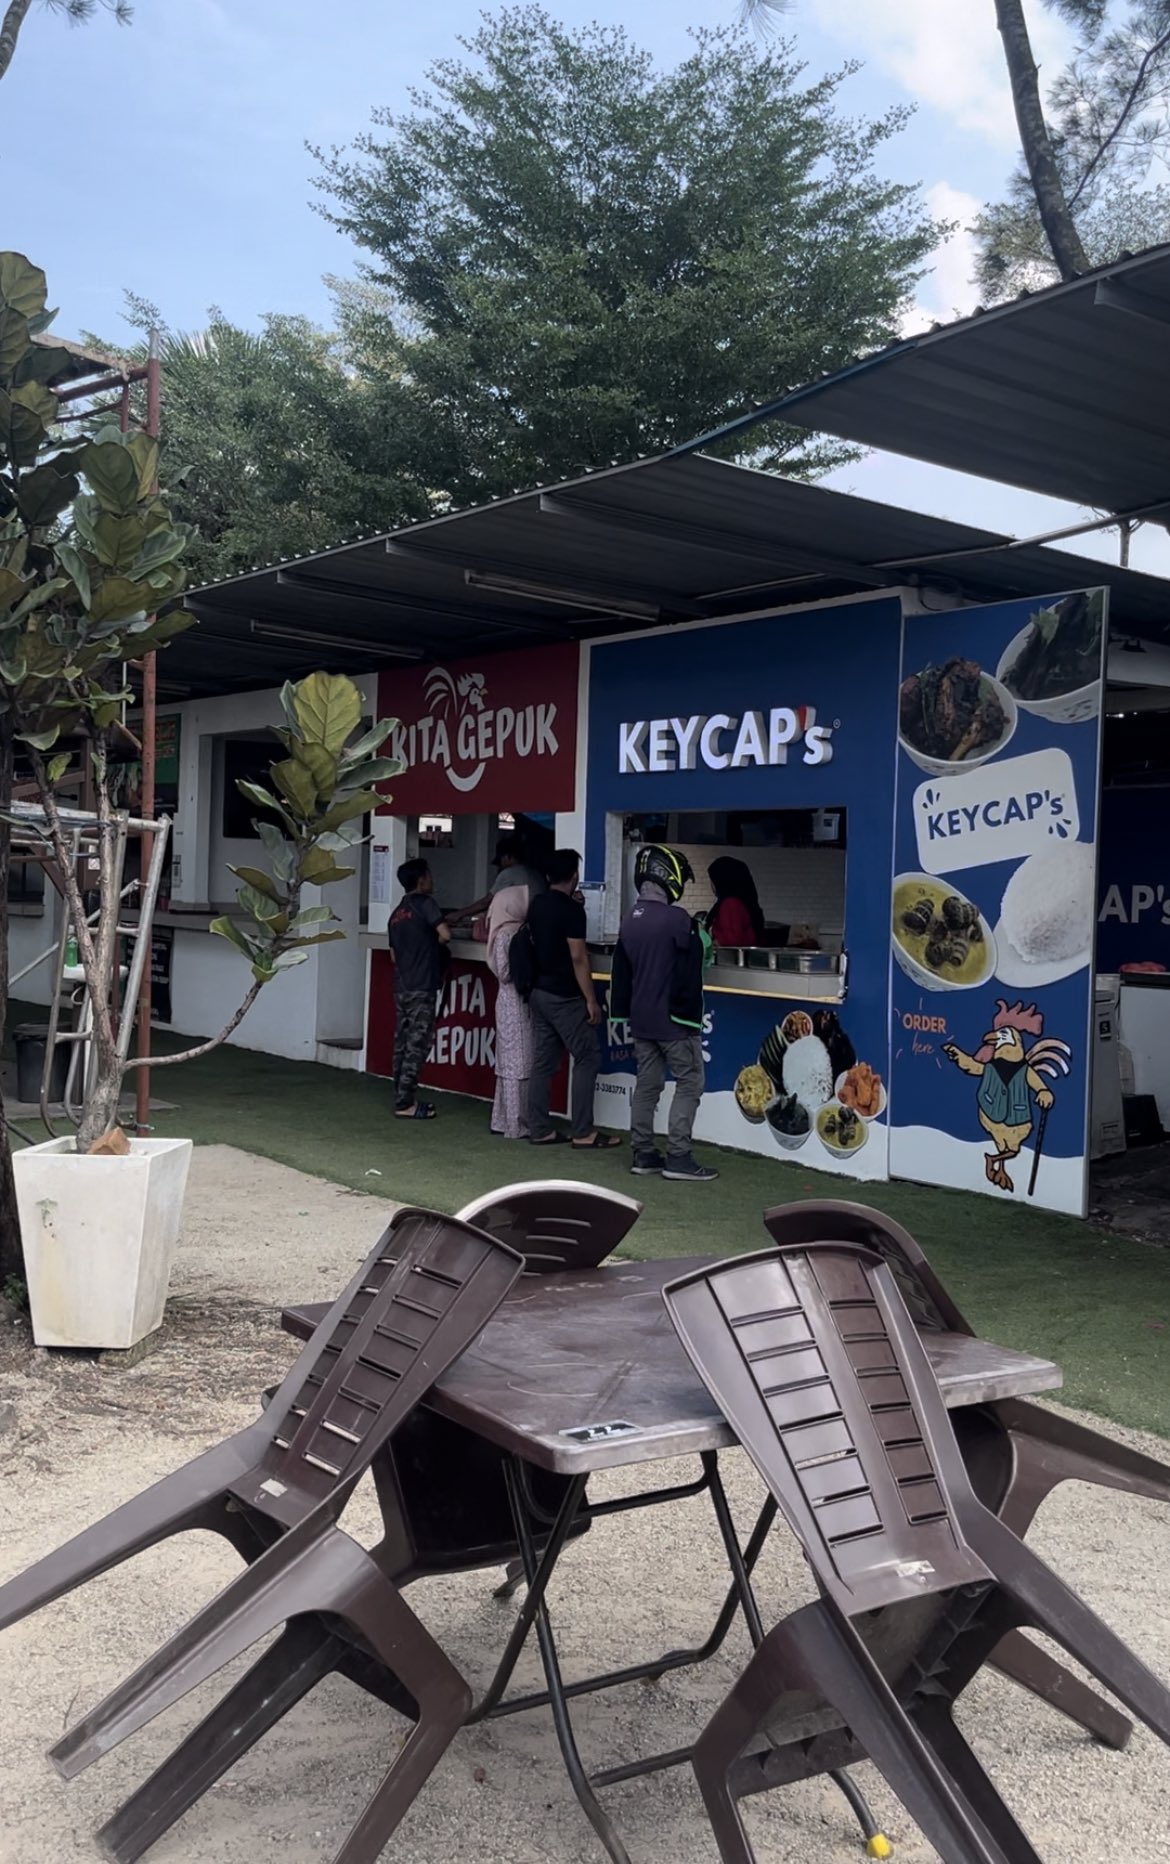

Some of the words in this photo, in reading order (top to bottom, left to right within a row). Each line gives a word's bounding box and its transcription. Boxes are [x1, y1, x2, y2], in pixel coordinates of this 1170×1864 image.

[392, 716, 450, 768] KITA
[457, 702, 559, 760] GEPUK
[903, 1013, 947, 1034] ORDER
[912, 1031, 934, 1055] here
